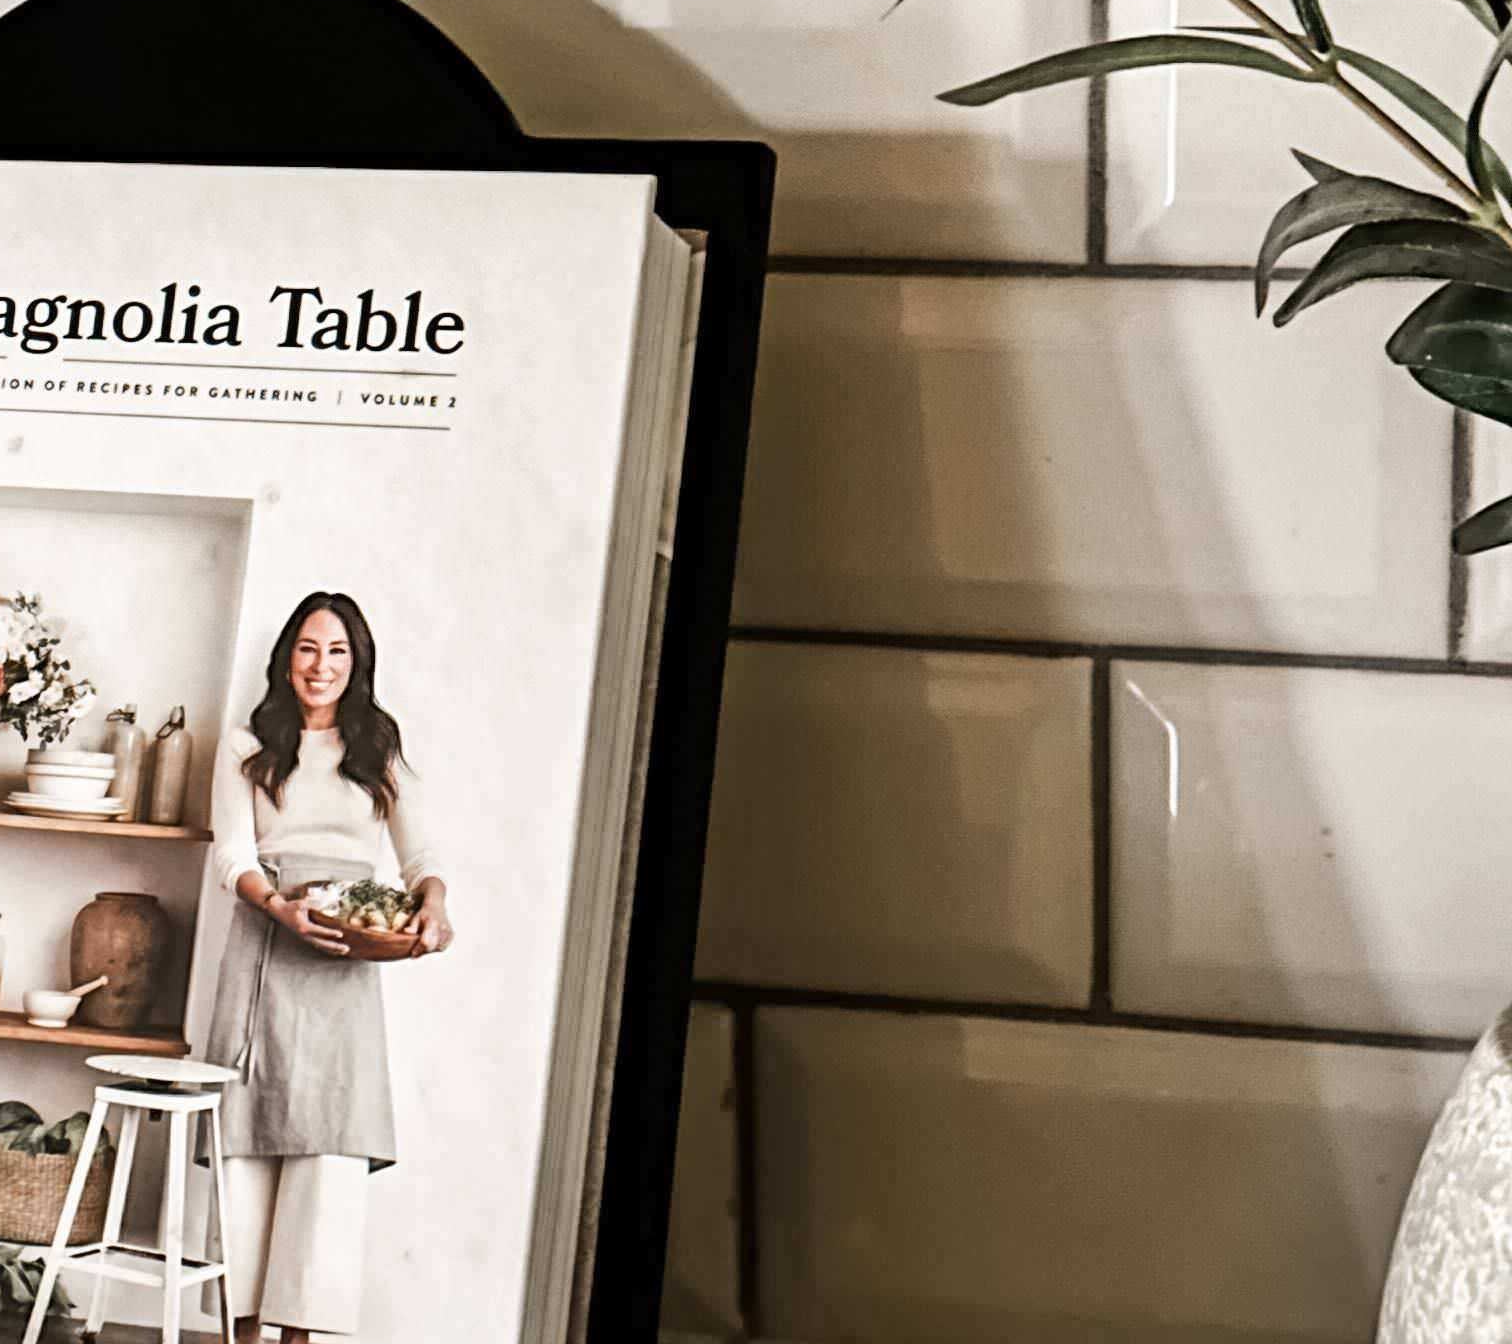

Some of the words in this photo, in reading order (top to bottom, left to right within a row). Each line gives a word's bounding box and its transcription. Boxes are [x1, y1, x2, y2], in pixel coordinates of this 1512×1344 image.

[269, 285, 465, 355] Table
[44, 380, 68, 392] OF
[76, 381, 154, 396] RECIPES
[163, 385, 200, 398] FOR
[208, 387, 319, 402] GATHERING
[361, 393, 439, 409] VOLUME
[448, 395, 458, 409] 2
